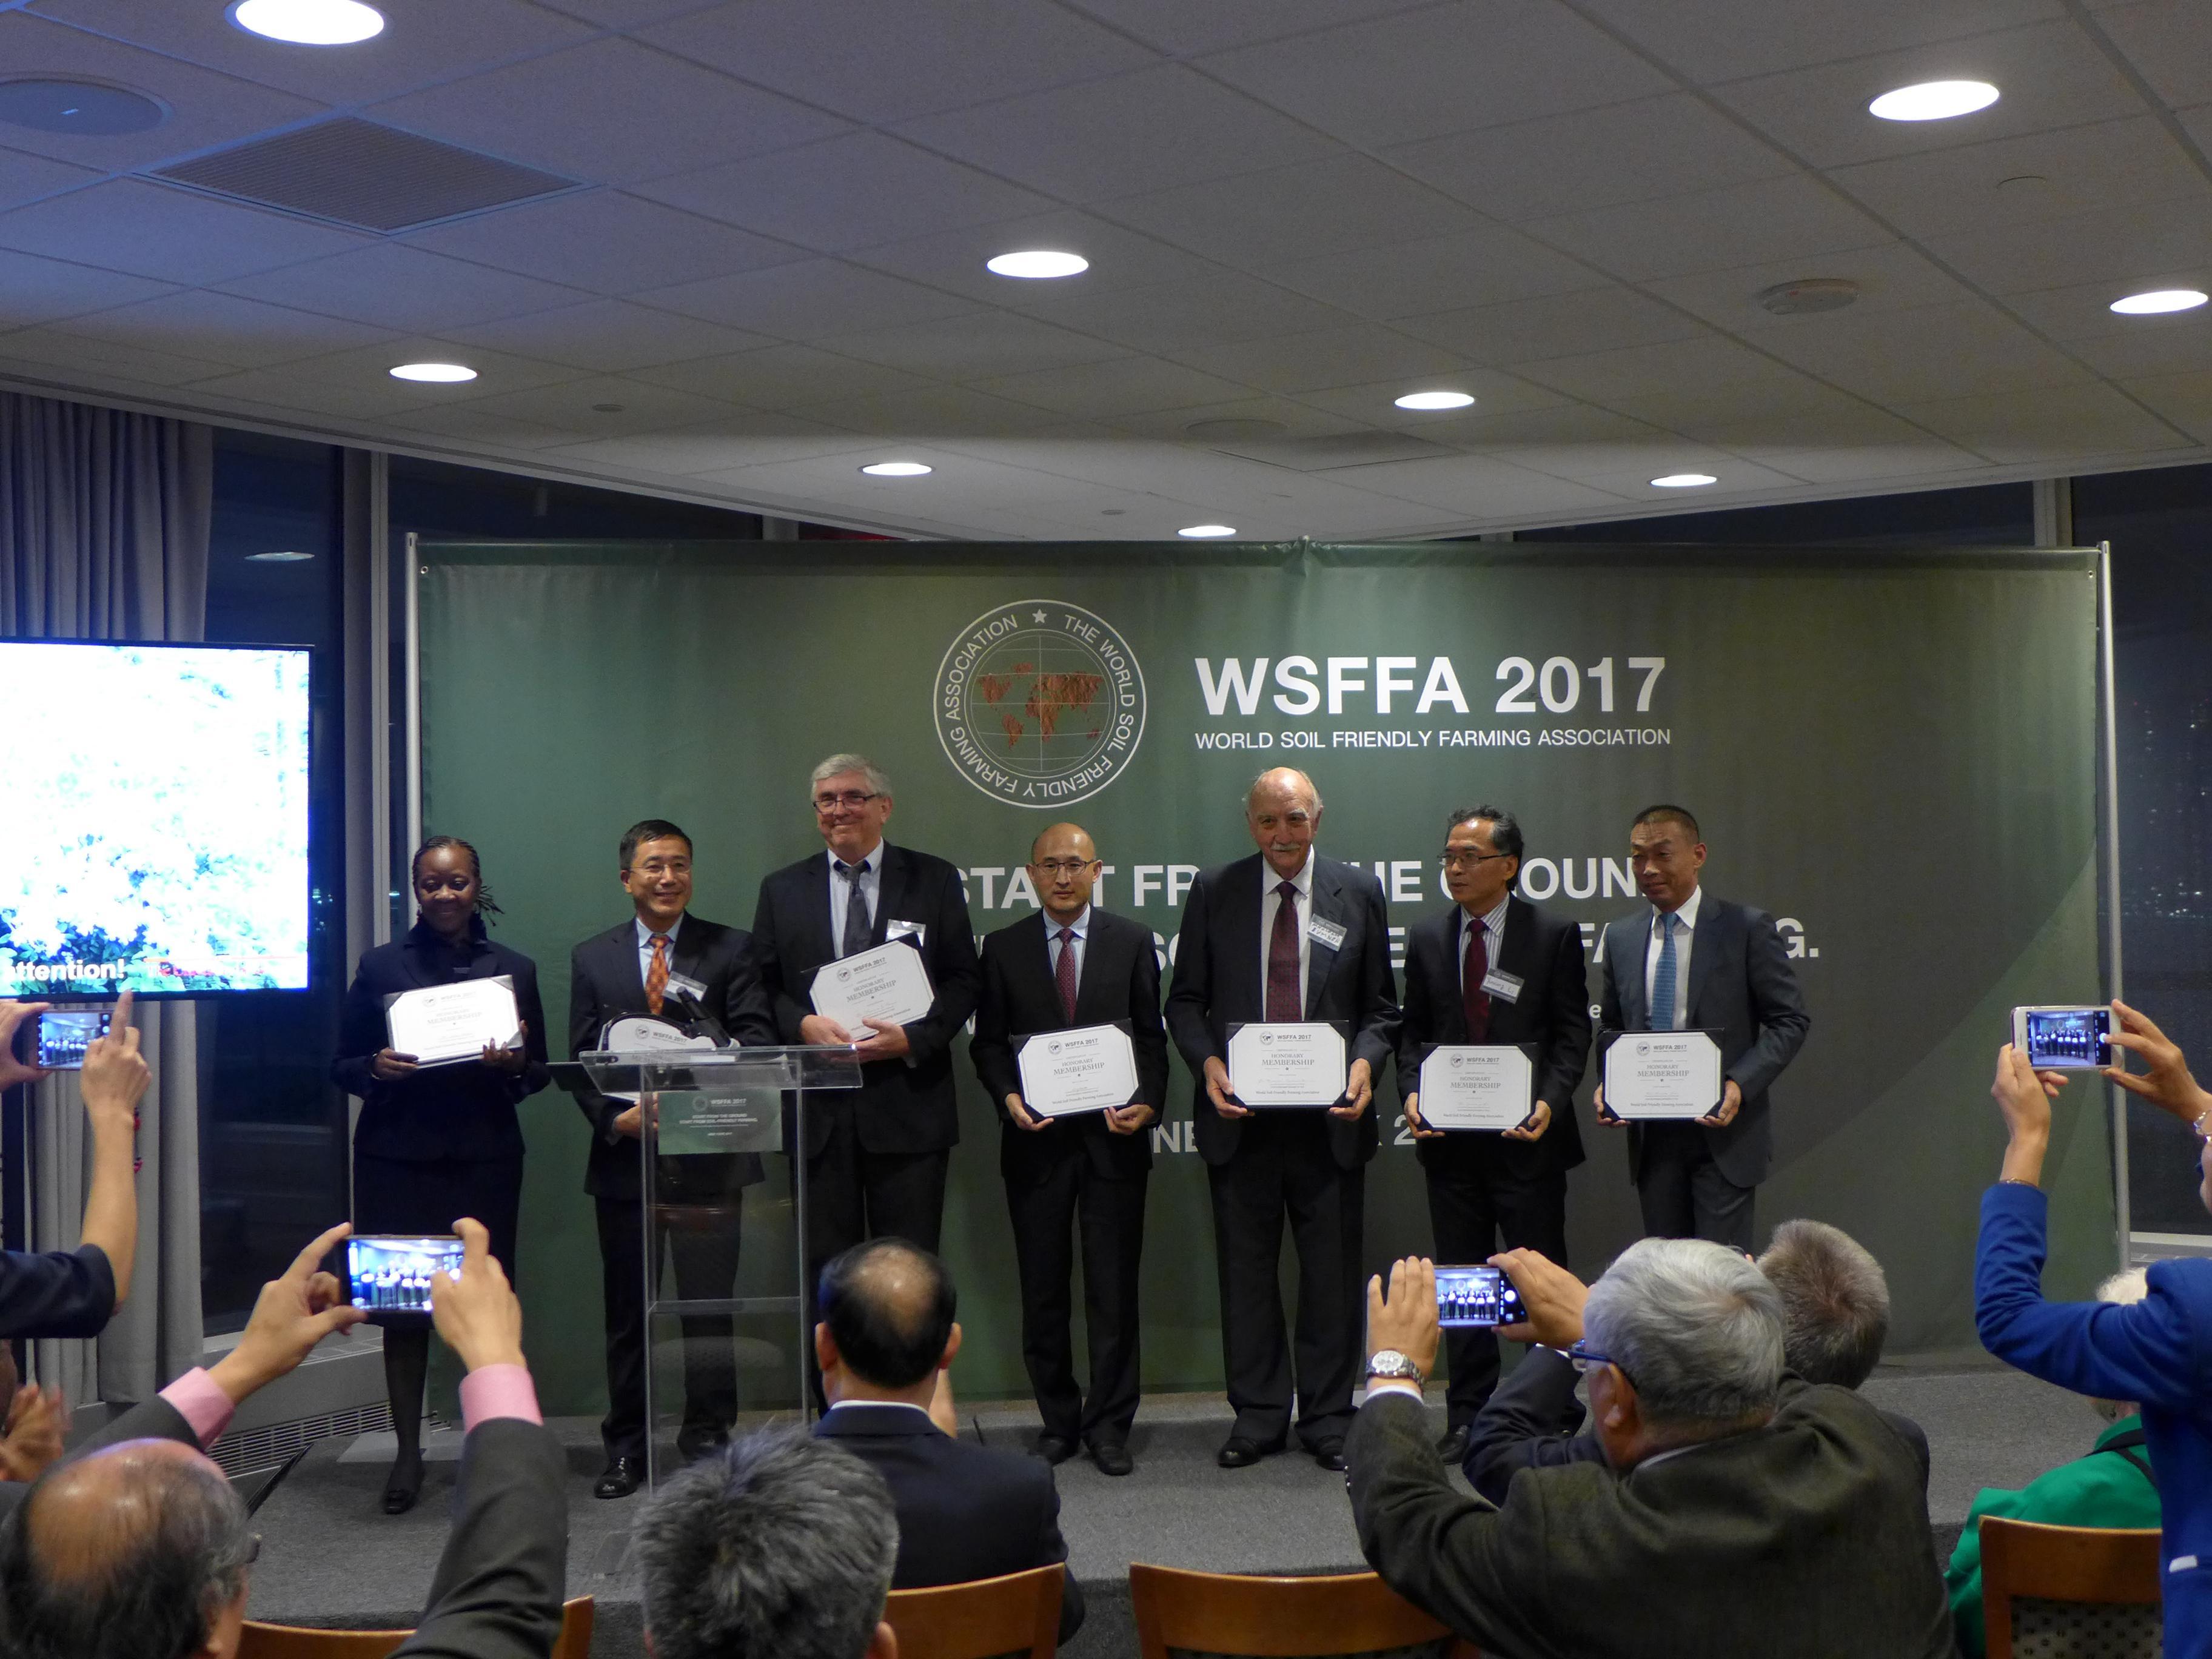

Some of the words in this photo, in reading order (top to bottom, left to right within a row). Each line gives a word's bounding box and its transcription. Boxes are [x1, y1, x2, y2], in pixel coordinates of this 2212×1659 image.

[1065, 614, 1100, 643] THE
[945, 614, 1018, 720] ASSOCIATION
[1099, 638, 1134, 707] WORLD
[1195, 655, 1470, 716] WSFFA
[1495, 656, 1665, 714] 2017
[1107, 713, 1134, 751] SOIL
[1195, 732, 1273, 749] WORLD
[1280, 731, 1326, 748] SOIL
[1333, 730, 1433, 748] FRIENDLY
[1439, 729, 1531, 747] FARMING
[1537, 729, 1670, 746] ASSOCIATION
[950, 726, 1017, 793] FARMING
[1023, 755, 1113, 797] FRIENDLY
[958, 865, 1114, 909] TAT
[846, 980, 896, 1001] MEMBERSHIP
[1053, 1062, 1105, 1076] MEMBERSHIP
